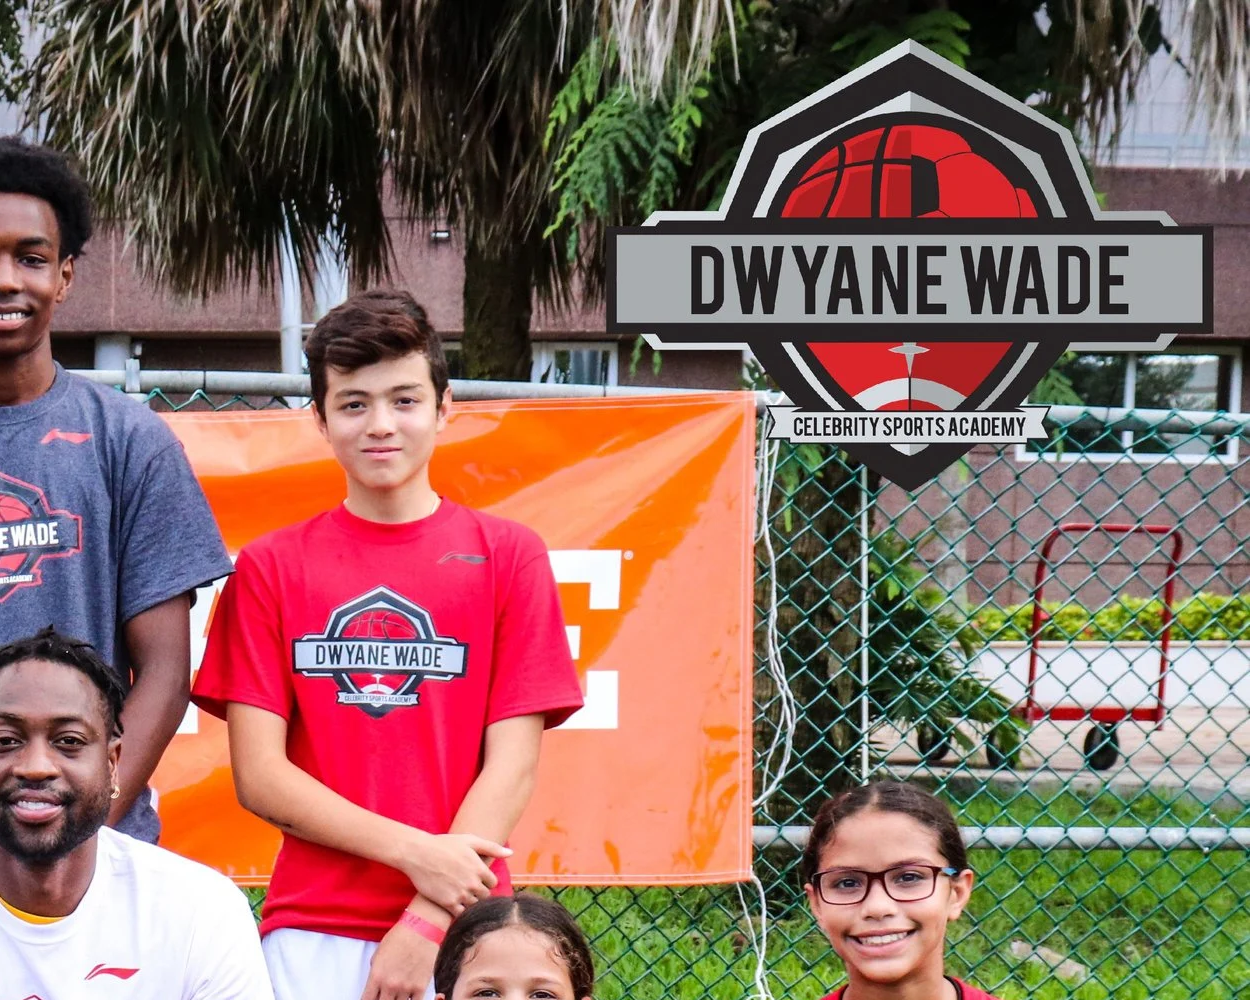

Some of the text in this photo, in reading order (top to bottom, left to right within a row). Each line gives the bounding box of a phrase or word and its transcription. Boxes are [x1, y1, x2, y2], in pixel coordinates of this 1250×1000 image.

[10, 521, 60, 547] WADE
[315, 644, 444, 668] DWYANE WADE
